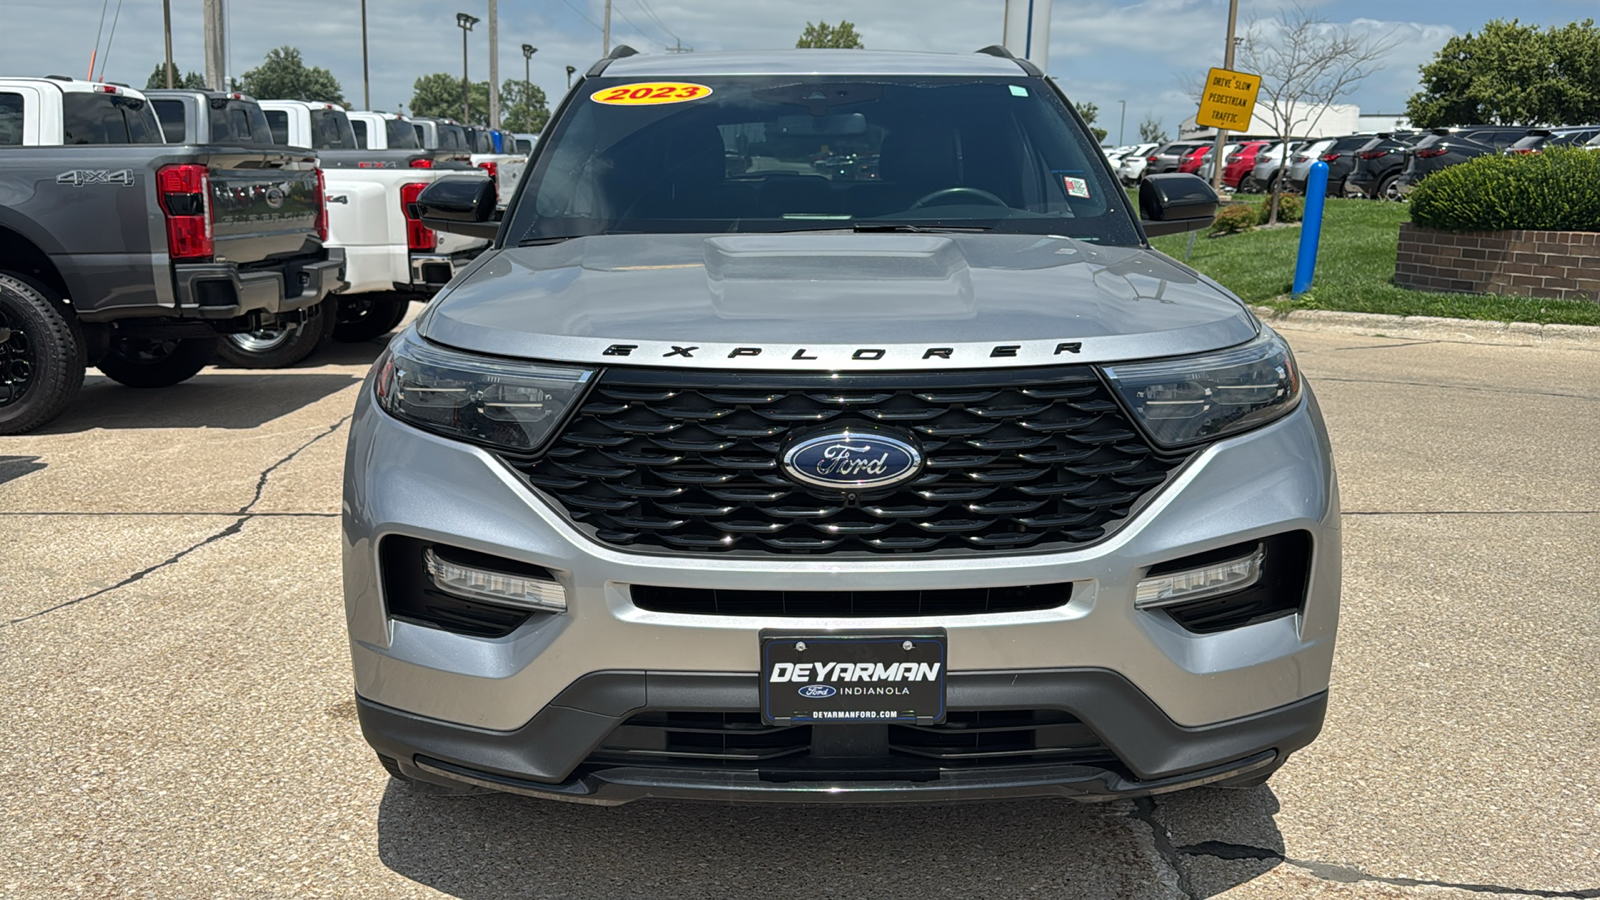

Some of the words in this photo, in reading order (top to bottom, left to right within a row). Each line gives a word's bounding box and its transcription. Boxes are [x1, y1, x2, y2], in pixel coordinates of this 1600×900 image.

[1212, 76, 1232, 88] DRIVE
[1234, 80, 1252, 91] SLOW
[602, 86, 701, 101] 2023
[1208, 93, 1248, 107] PEDESTRIAN
[1212, 111, 1238, 123] TRAFFIC
[56, 169, 135, 188] 4X4
[602, 341, 1084, 361] EXPLORER
[817, 444, 889, 475] Ford
[769, 661, 941, 683] DEYARMAN
[805, 685, 829, 697] Ford
[840, 686, 910, 695] INDIANOLA
[813, 710, 898, 719] DEYARMANFORD.COM
